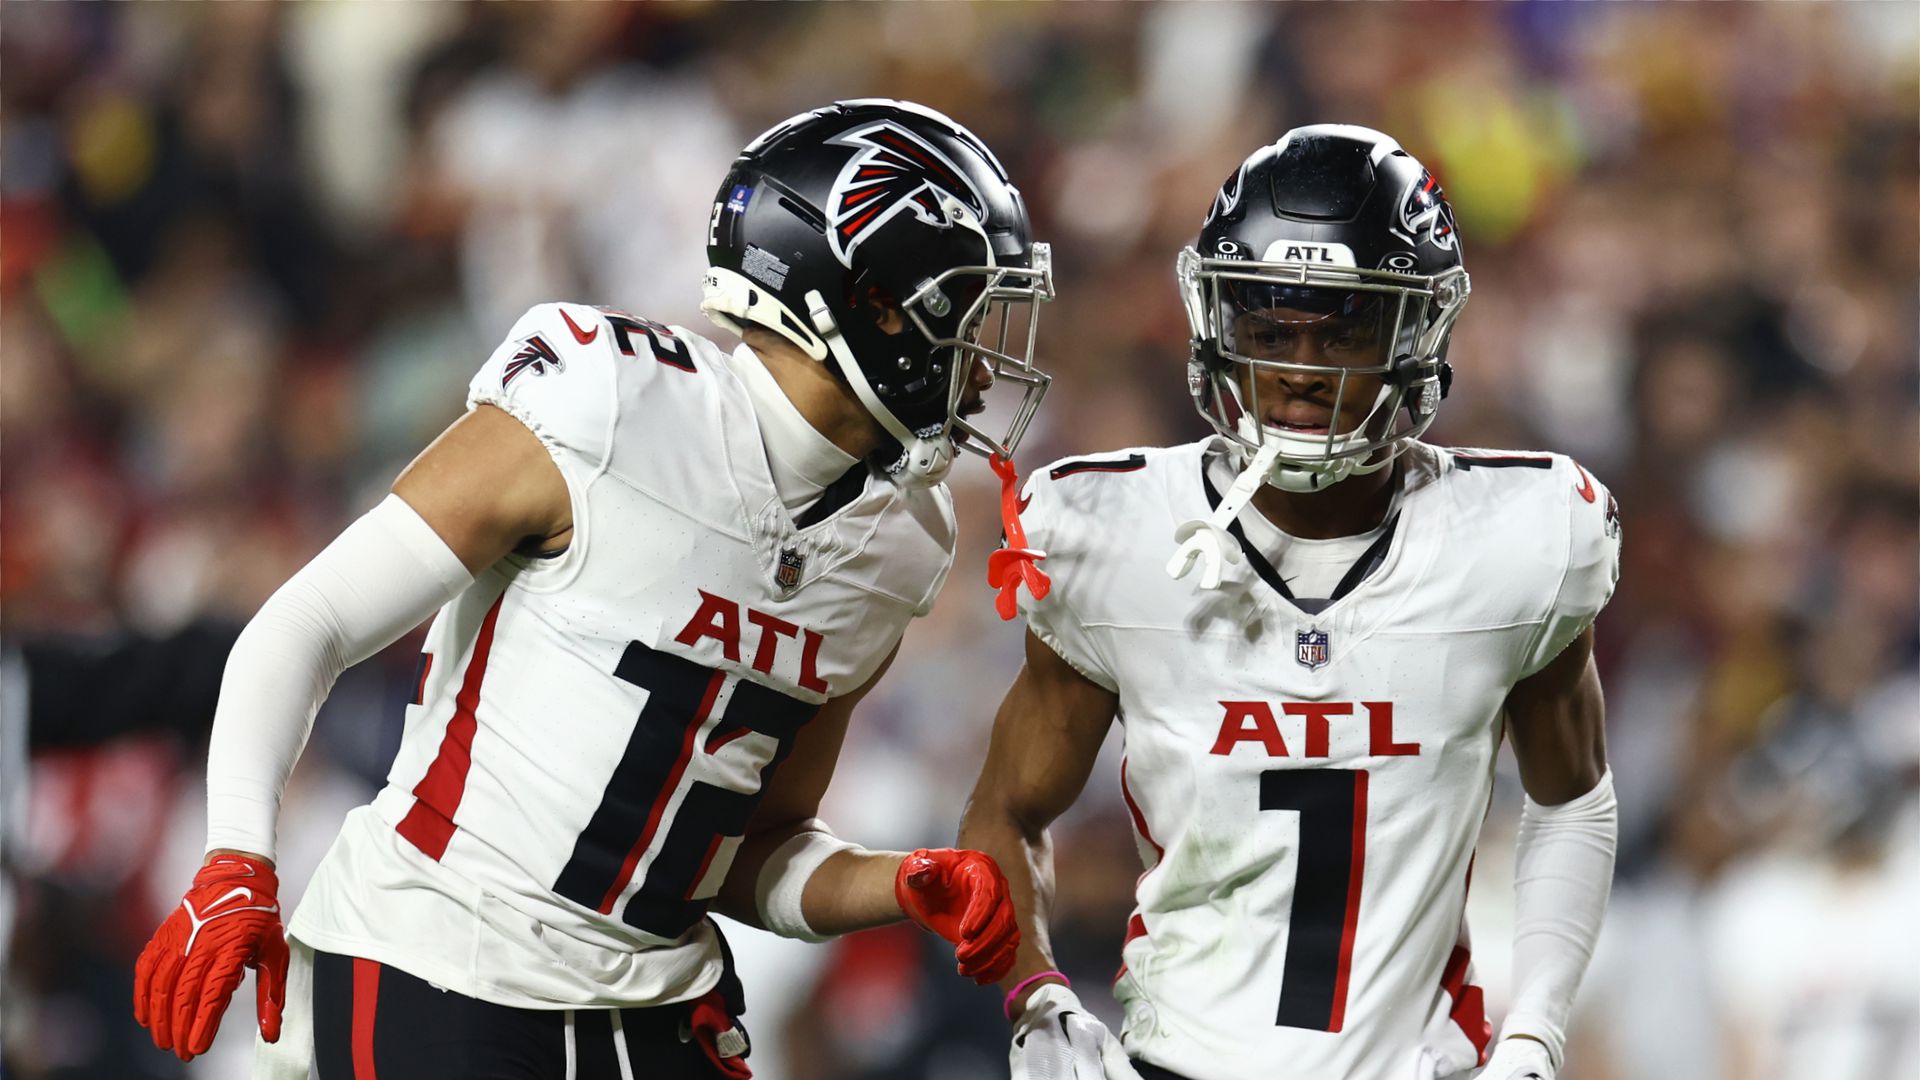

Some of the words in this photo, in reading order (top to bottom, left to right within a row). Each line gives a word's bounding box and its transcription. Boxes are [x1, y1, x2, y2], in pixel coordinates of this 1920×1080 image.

[1284, 246, 1333, 262] ATL
[674, 588, 828, 694] ATL
[1300, 645, 1325, 662] NFL
[1209, 701, 1420, 758] ATL
[552, 640, 823, 939] 12
[1259, 769, 1368, 1033] 1
